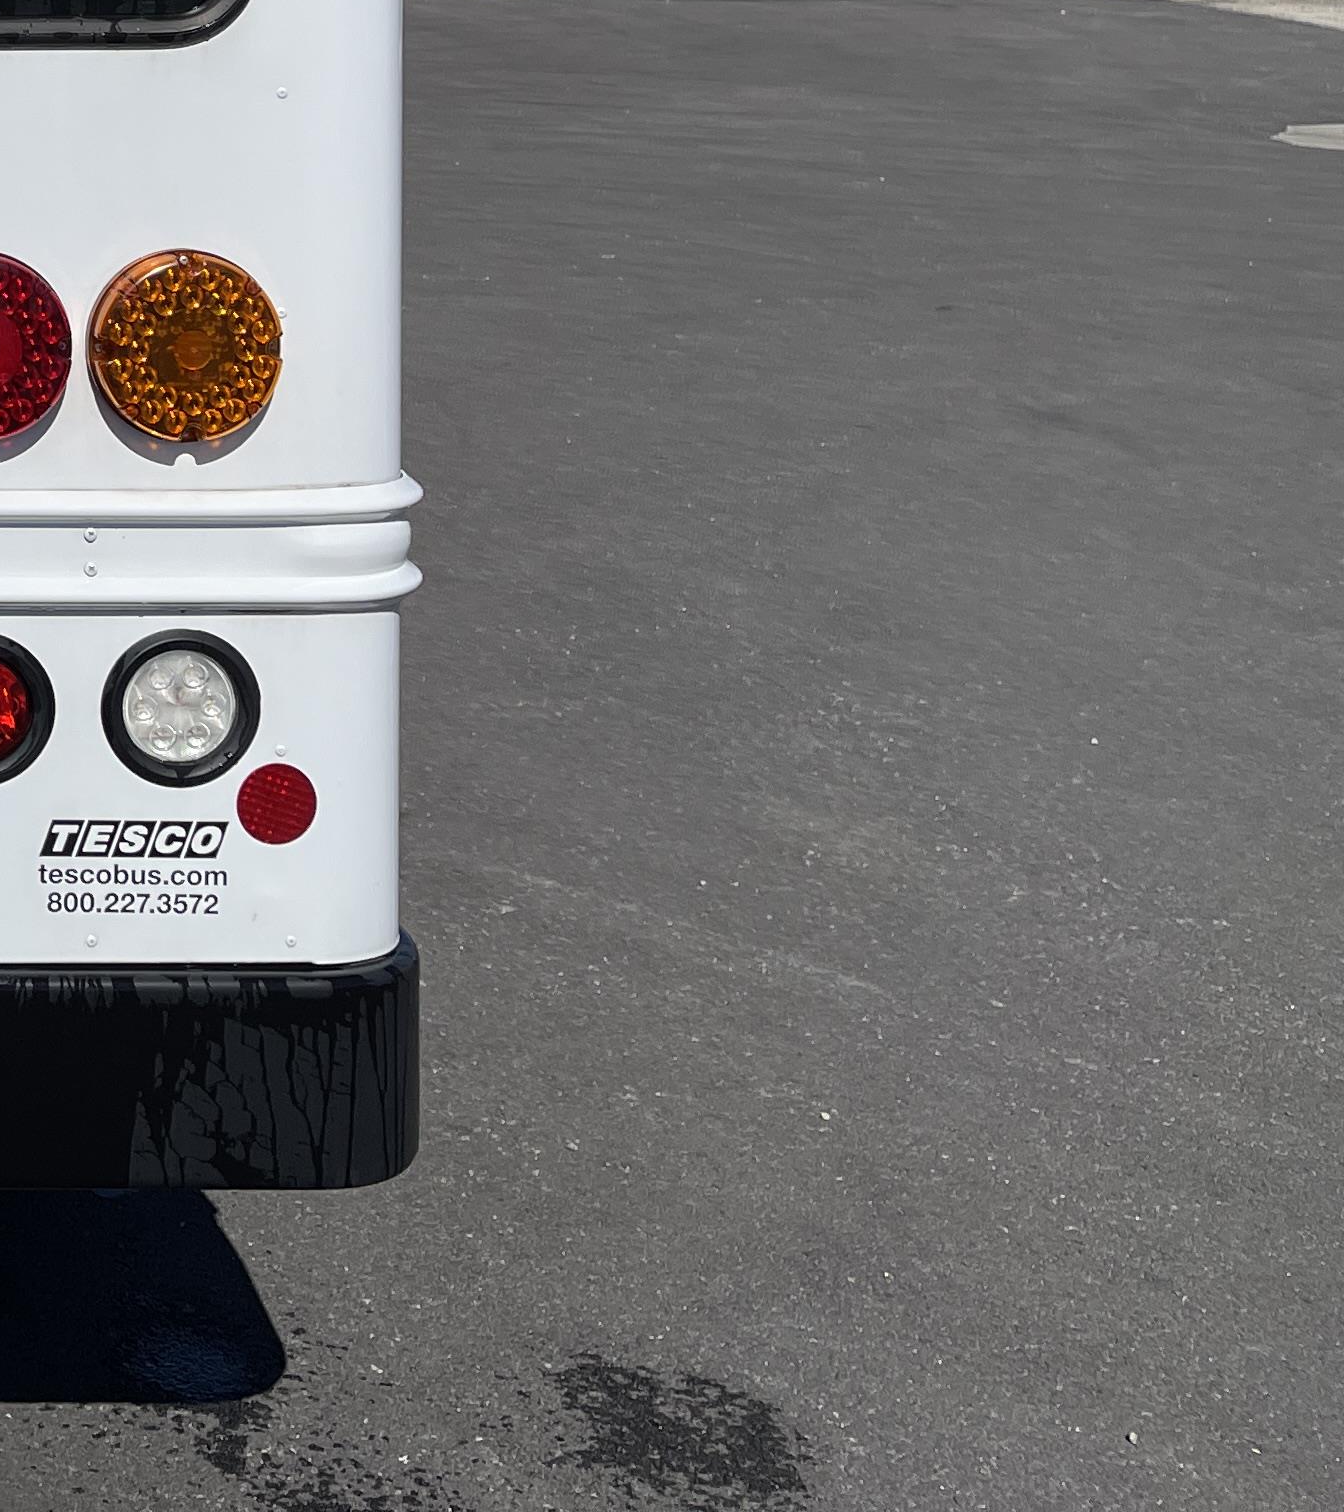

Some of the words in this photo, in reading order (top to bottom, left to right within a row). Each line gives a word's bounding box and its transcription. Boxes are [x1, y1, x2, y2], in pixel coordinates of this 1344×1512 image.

[41, 821, 227, 857] TESCO
[38, 863, 228, 887] tescobus.com
[46, 892, 220, 915] 800.227.3572
